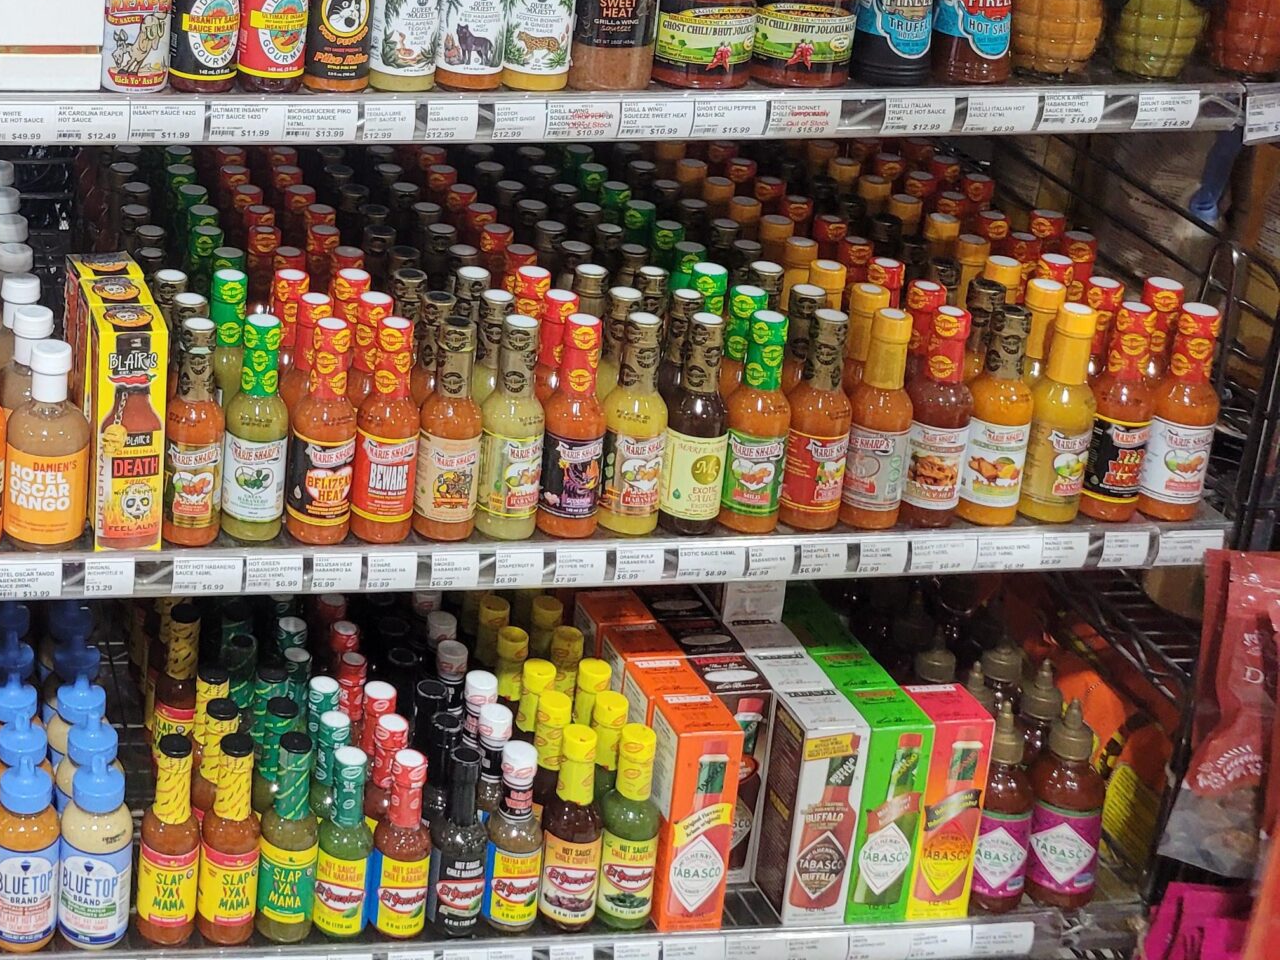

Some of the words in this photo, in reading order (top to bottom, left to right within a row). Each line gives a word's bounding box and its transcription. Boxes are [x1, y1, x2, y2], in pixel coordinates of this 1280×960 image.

[603, 7, 632, 18] HEAT
[912, 122, 940, 131] $12.99
[1071, 116, 1098, 124] $14.99
[1162, 120, 1190, 128] $14.99
[12, 132, 41, 140] $49.99
[88, 132, 116, 140] $12.49
[161, 131, 189, 139] $11.99
[316, 129, 344, 138] $13.99
[650, 128, 678, 136] $10.99
[10, 462, 68, 484] HOTEL
[112, 458, 159, 478] DEATH
[369, 462, 408, 492] BEWARE
[10, 480, 69, 498] OSCAR
[318, 489, 346, 502] HEAT
[692, 486, 717, 494] EXOTIC
[10, 494, 70, 511] TANGO
[804, 811, 845, 825] BUFFALO
[862, 851, 911, 865] TABASCO
[922, 849, 970, 863] TABASCO
[672, 865, 722, 879] TABASCO
[799, 858, 845, 873] TABASCO
[155, 871, 182, 886] SLAP
[222, 871, 249, 886] SLAP
[273, 867, 302, 883] SLAP
[9, 895, 39, 906] BRAND
[72, 894, 101, 907] BRAND
[152, 896, 185, 911] MAMA
[268, 892, 302, 908] MAMA
